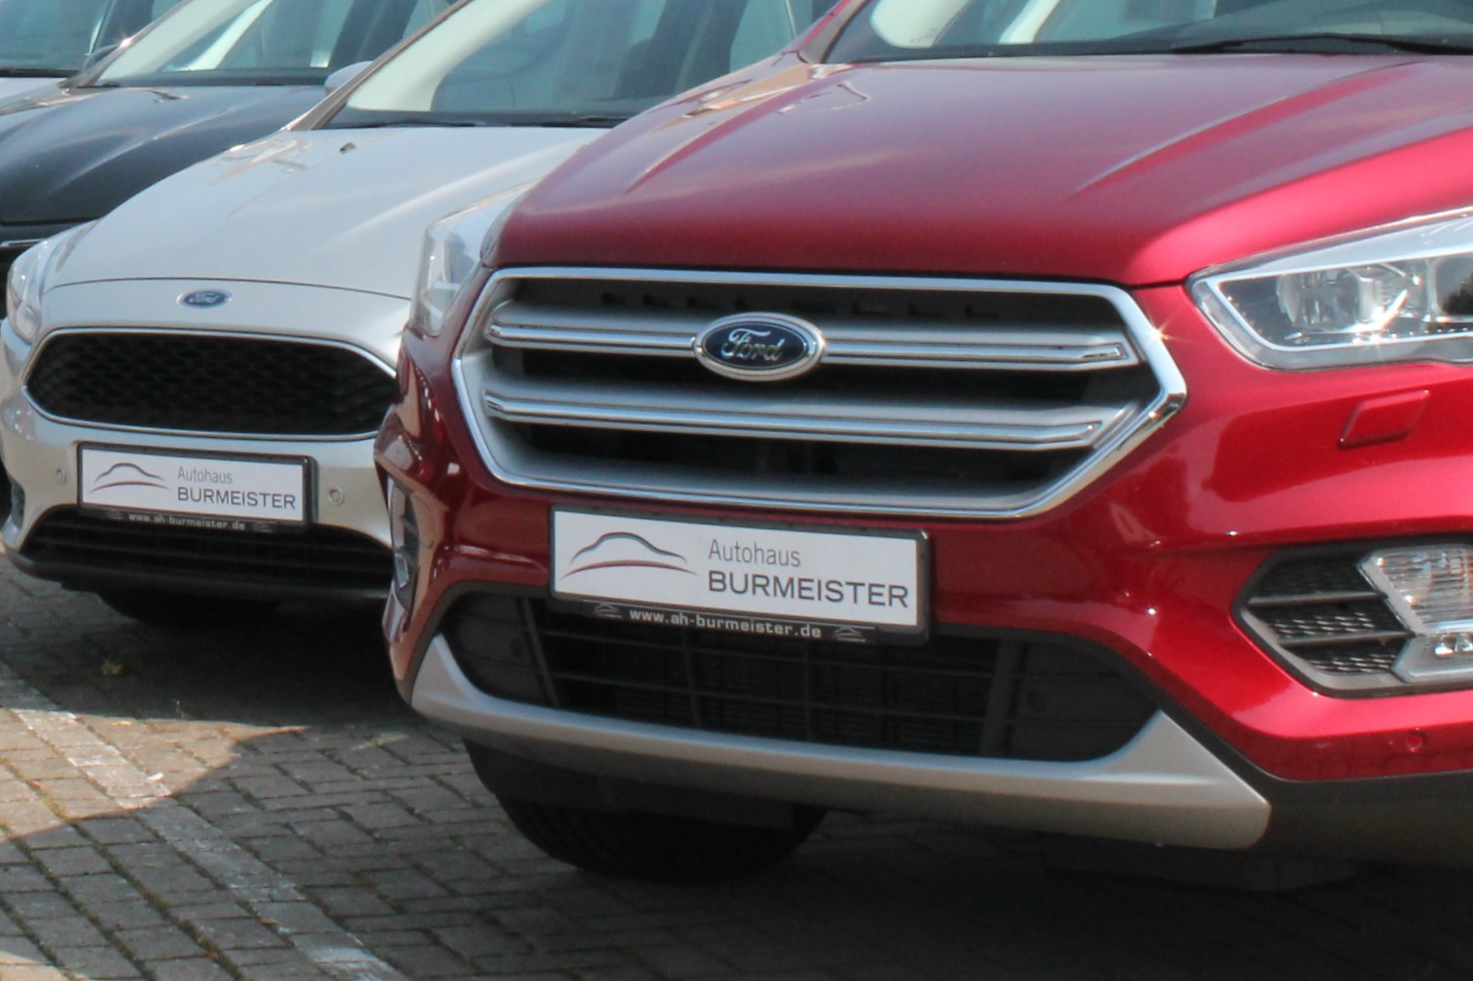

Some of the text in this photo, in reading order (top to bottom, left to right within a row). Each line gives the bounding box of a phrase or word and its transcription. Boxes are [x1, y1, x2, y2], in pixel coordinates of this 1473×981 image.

[720, 328, 786, 361] Ford
[177, 466, 233, 484] Autohaus
[177, 486, 296, 509] BURMEISTER
[128, 513, 246, 531] www.ah-burmeister.de
[708, 538, 801, 568] Autohaus
[708, 570, 909, 608] BURMEISTER
[629, 609, 822, 639] www.ah-burmeister.de
